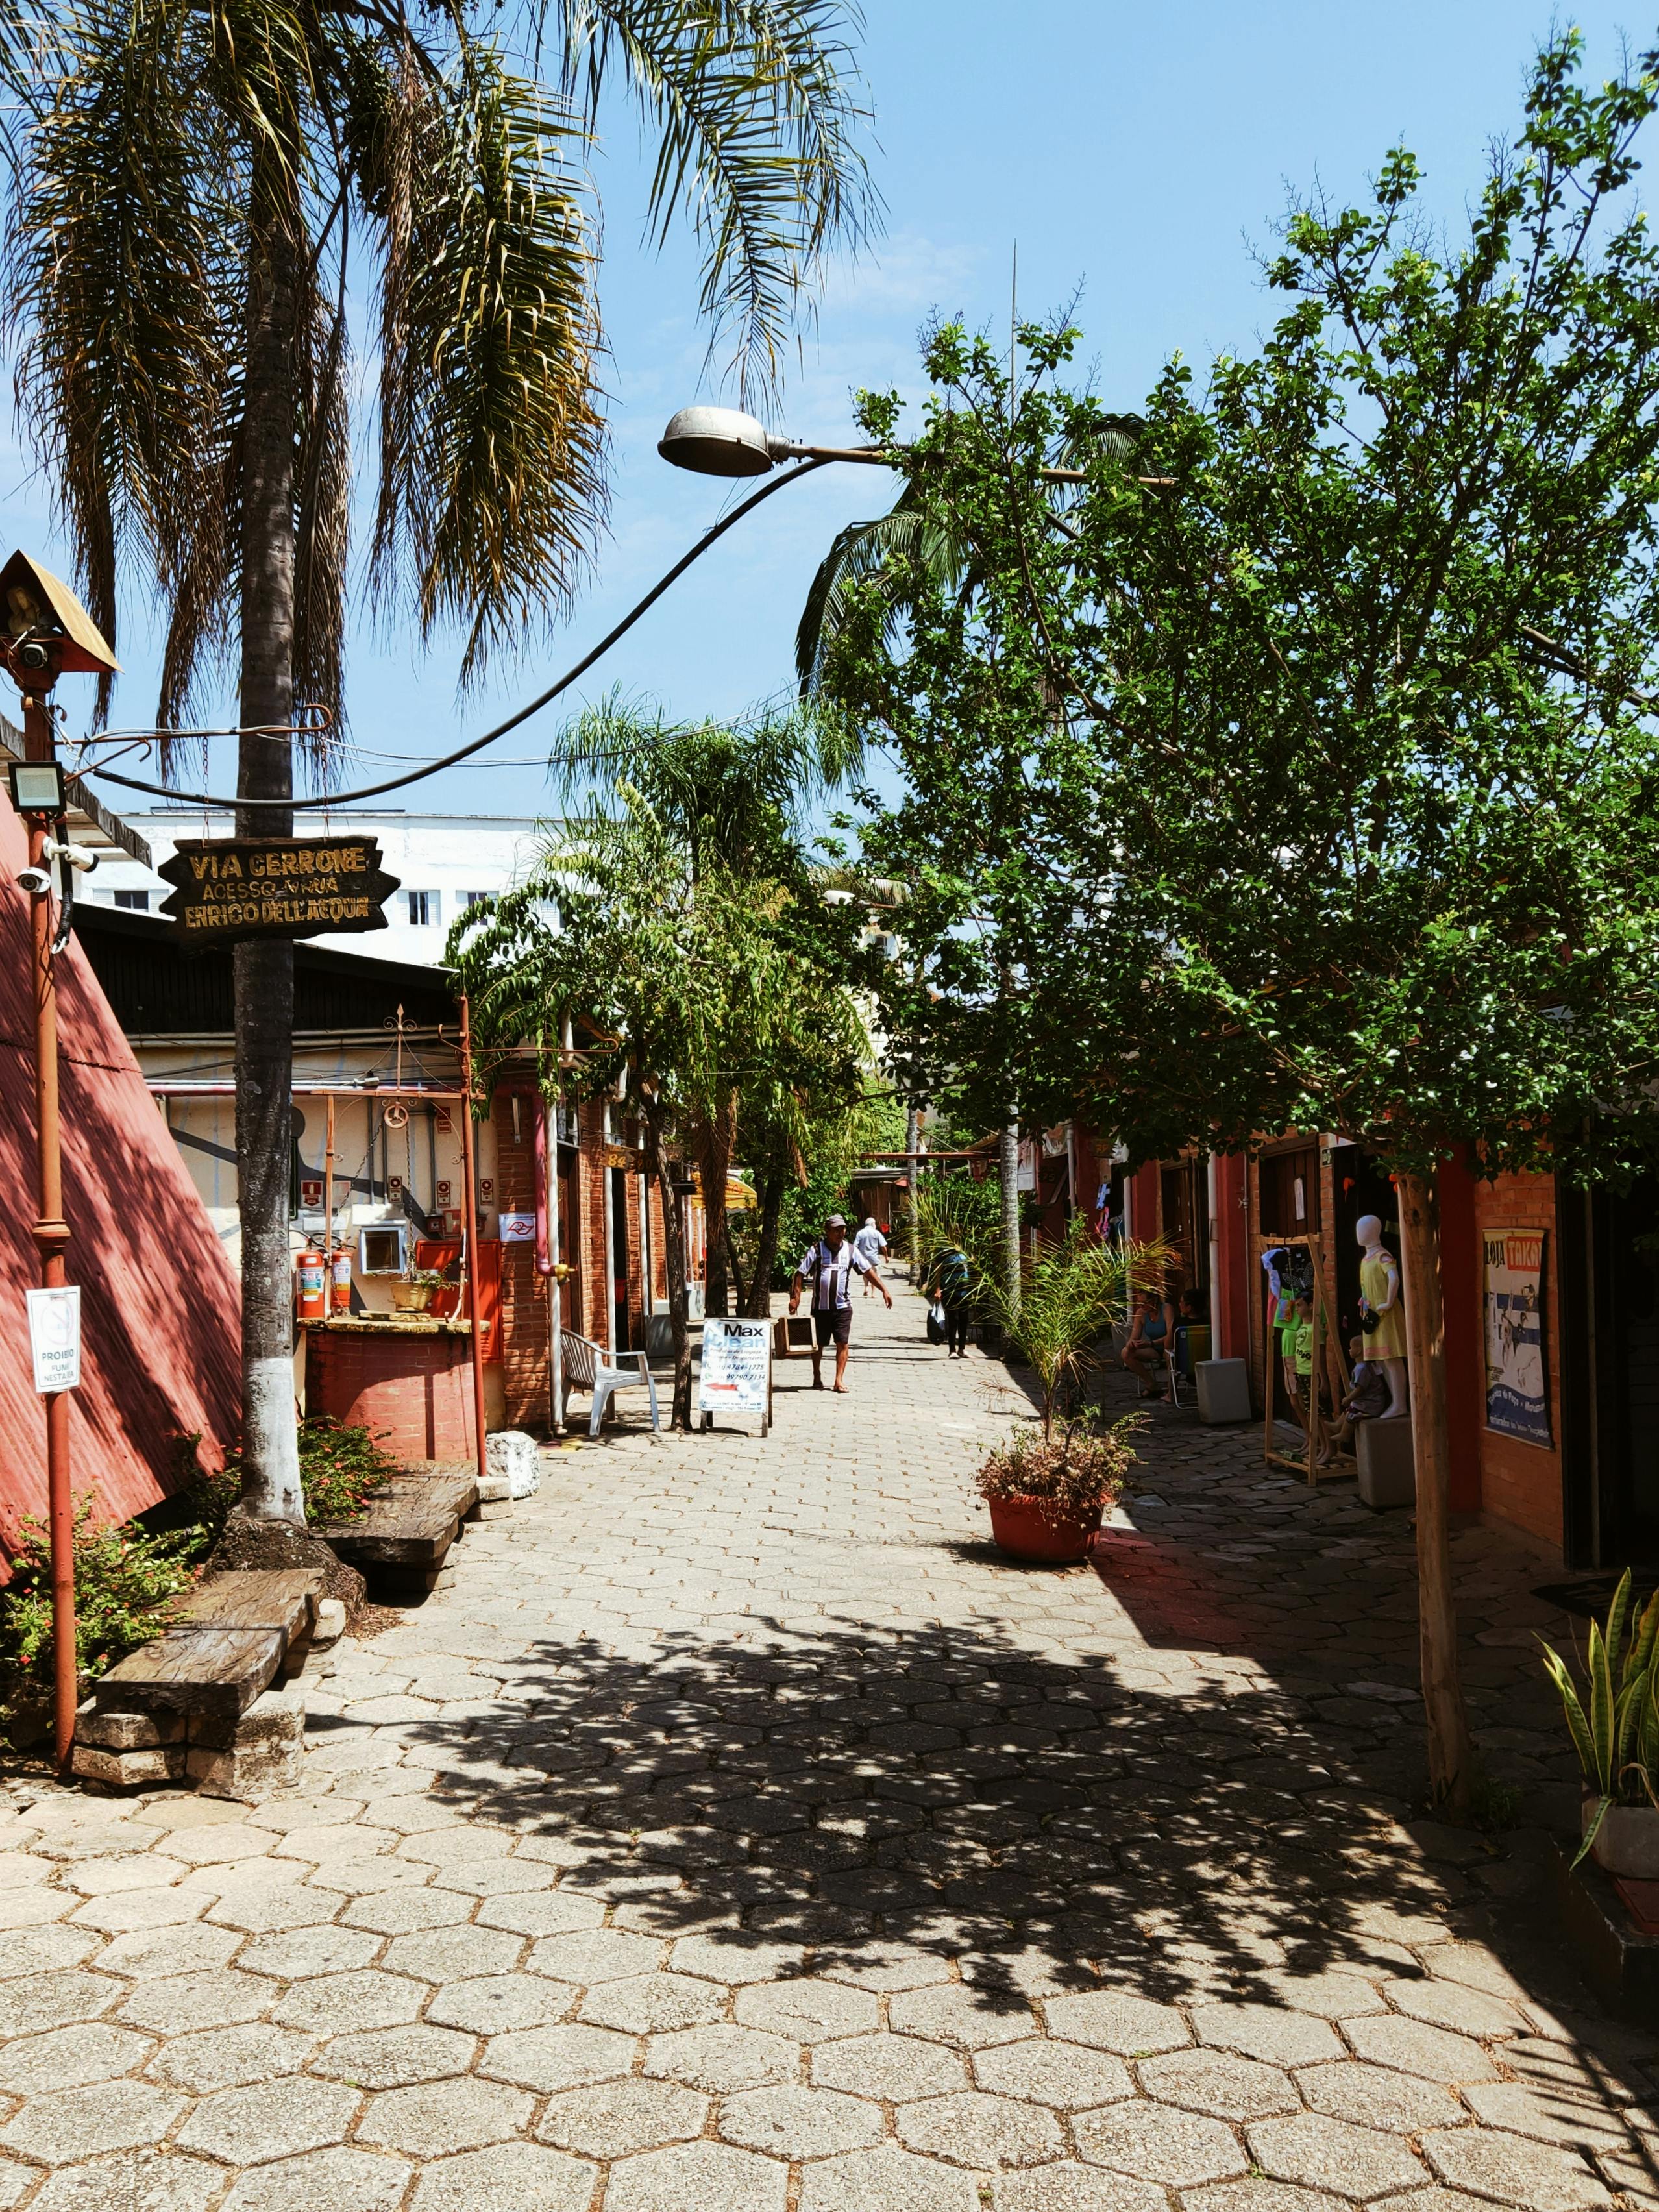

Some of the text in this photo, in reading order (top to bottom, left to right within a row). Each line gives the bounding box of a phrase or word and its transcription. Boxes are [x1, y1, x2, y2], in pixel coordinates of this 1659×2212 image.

[189, 847, 367, 879] VIA CERRONE
[203, 881, 276, 901] ACESSO
[185, 903, 258, 928] ENRICO
[1484, 1240, 1505, 1268] LOJA
[724, 1324, 763, 1337] Max
